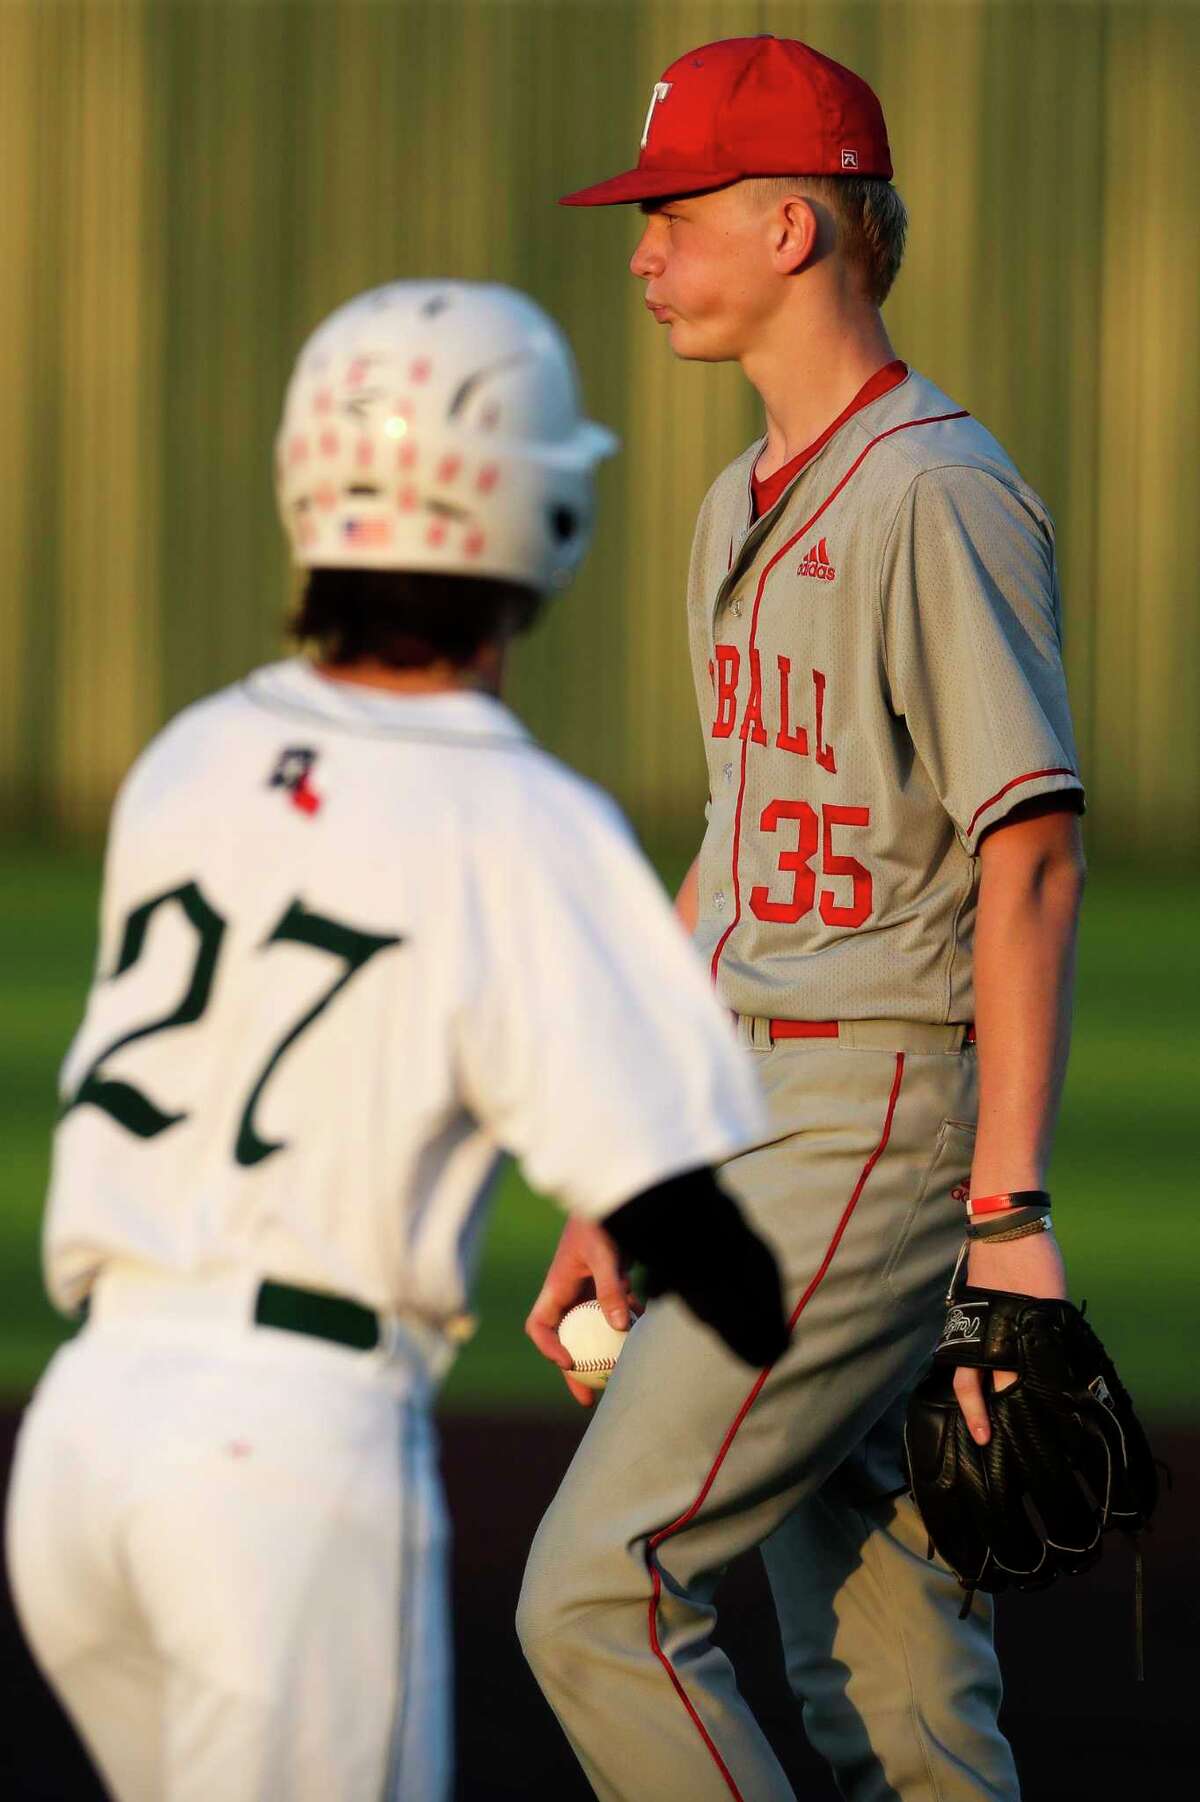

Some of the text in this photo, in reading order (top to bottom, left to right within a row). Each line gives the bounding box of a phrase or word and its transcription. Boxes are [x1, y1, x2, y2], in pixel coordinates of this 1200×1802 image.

[797, 562, 836, 581] adidas
[709, 644, 838, 774] BALL
[749, 799, 873, 928] 35
[60, 877, 406, 1166] 27
